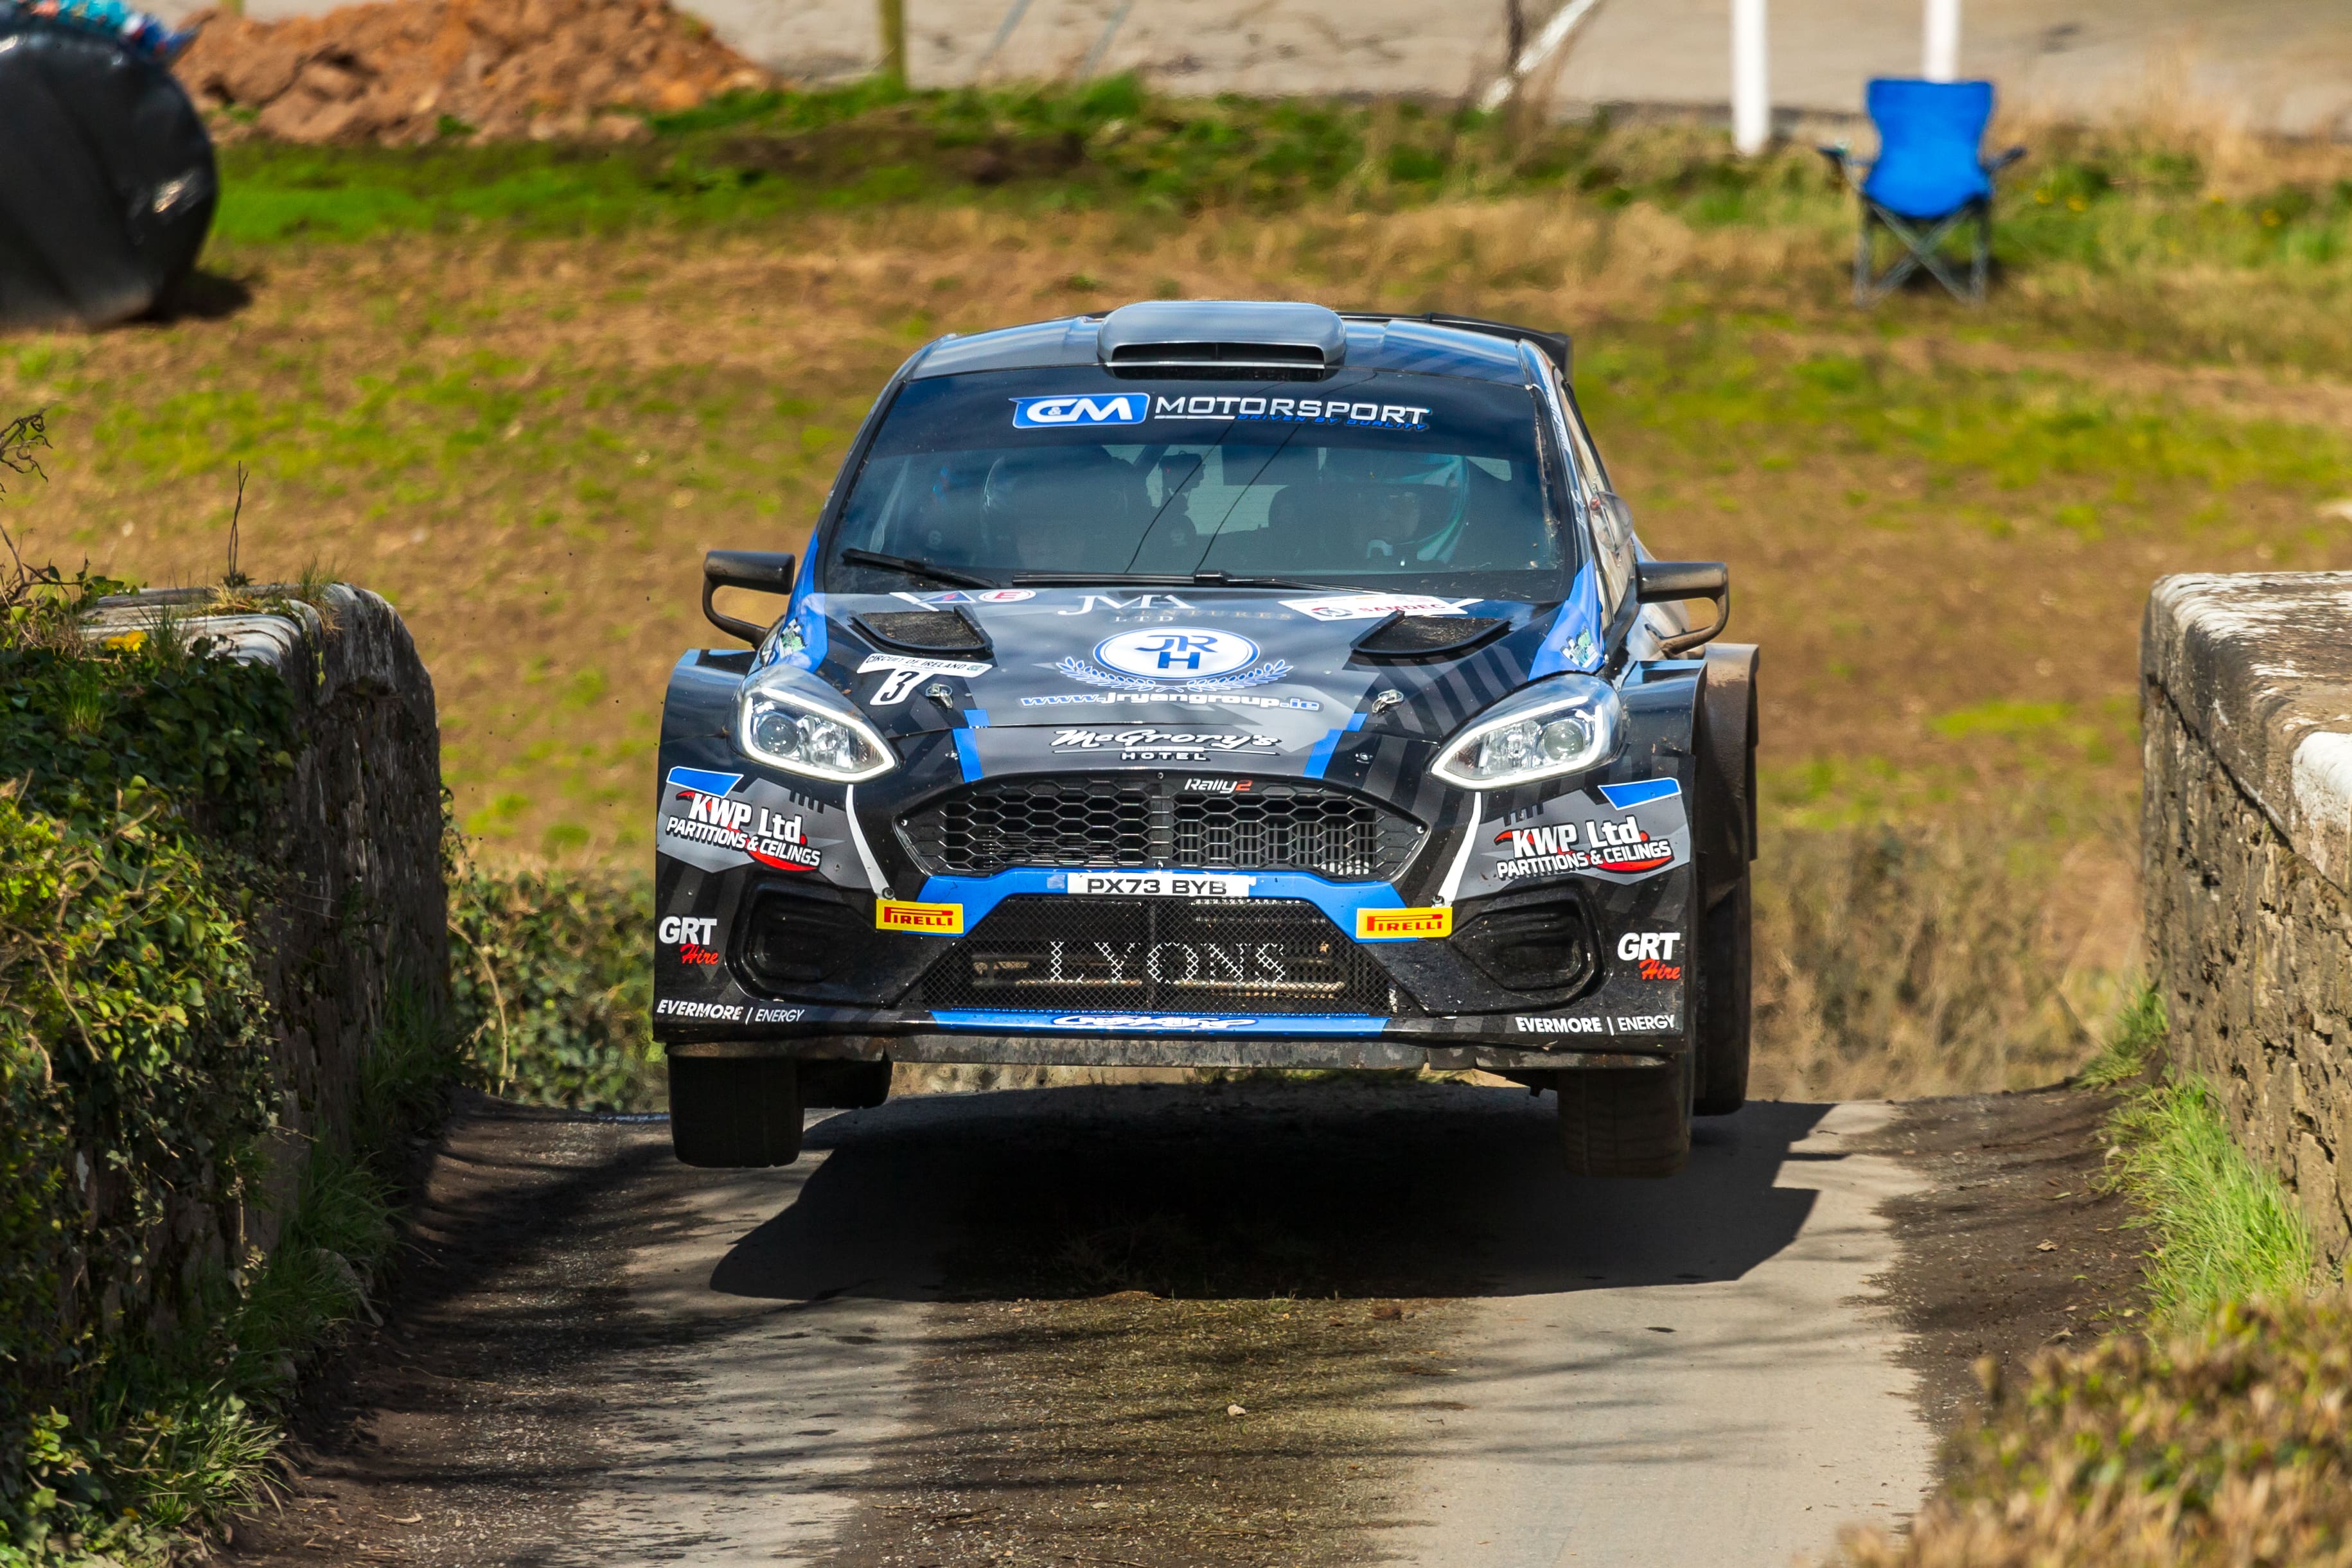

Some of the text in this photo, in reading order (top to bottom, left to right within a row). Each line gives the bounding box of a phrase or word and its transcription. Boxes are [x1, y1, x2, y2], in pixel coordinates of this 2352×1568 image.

[1027, 396, 1431, 425] C&M MOTORSPORT
[1236, 414, 1427, 430] DRIVEN BY QUALITY
[1057, 594, 1196, 615] JMA
[1358, 604, 1446, 613] SAMDEC
[865, 655, 905, 664] CIRCUIT
[921, 660, 968, 669] IRELAND
[880, 671, 920, 702] 3
[1050, 729, 1280, 750] McGrory's
[1121, 752, 1208, 761] HOTEL
[1184, 777, 1253, 794] Rally2
[688, 793, 752, 831] KWP
[666, 816, 821, 867] PARTITIONS & CEILINGS
[1512, 824, 1578, 858] KWP
[1496, 840, 1672, 878] PARTITIONS & CEILINGS
[1087, 878, 1227, 895] PX73 BYB
[884, 906, 953, 926] PIRELLI
[1366, 913, 1443, 931] PIRELLI
[659, 916, 718, 946] GRT
[680, 943, 719, 965] Hire
[1617, 932, 1681, 961] GRT
[1049, 940, 1286, 984] LYONS
[1639, 958, 1681, 980] Hire
[656, 999, 806, 1023] EVERMORE ENERGY
[1515, 1014, 1676, 1033] EVERMORE ENERGY
